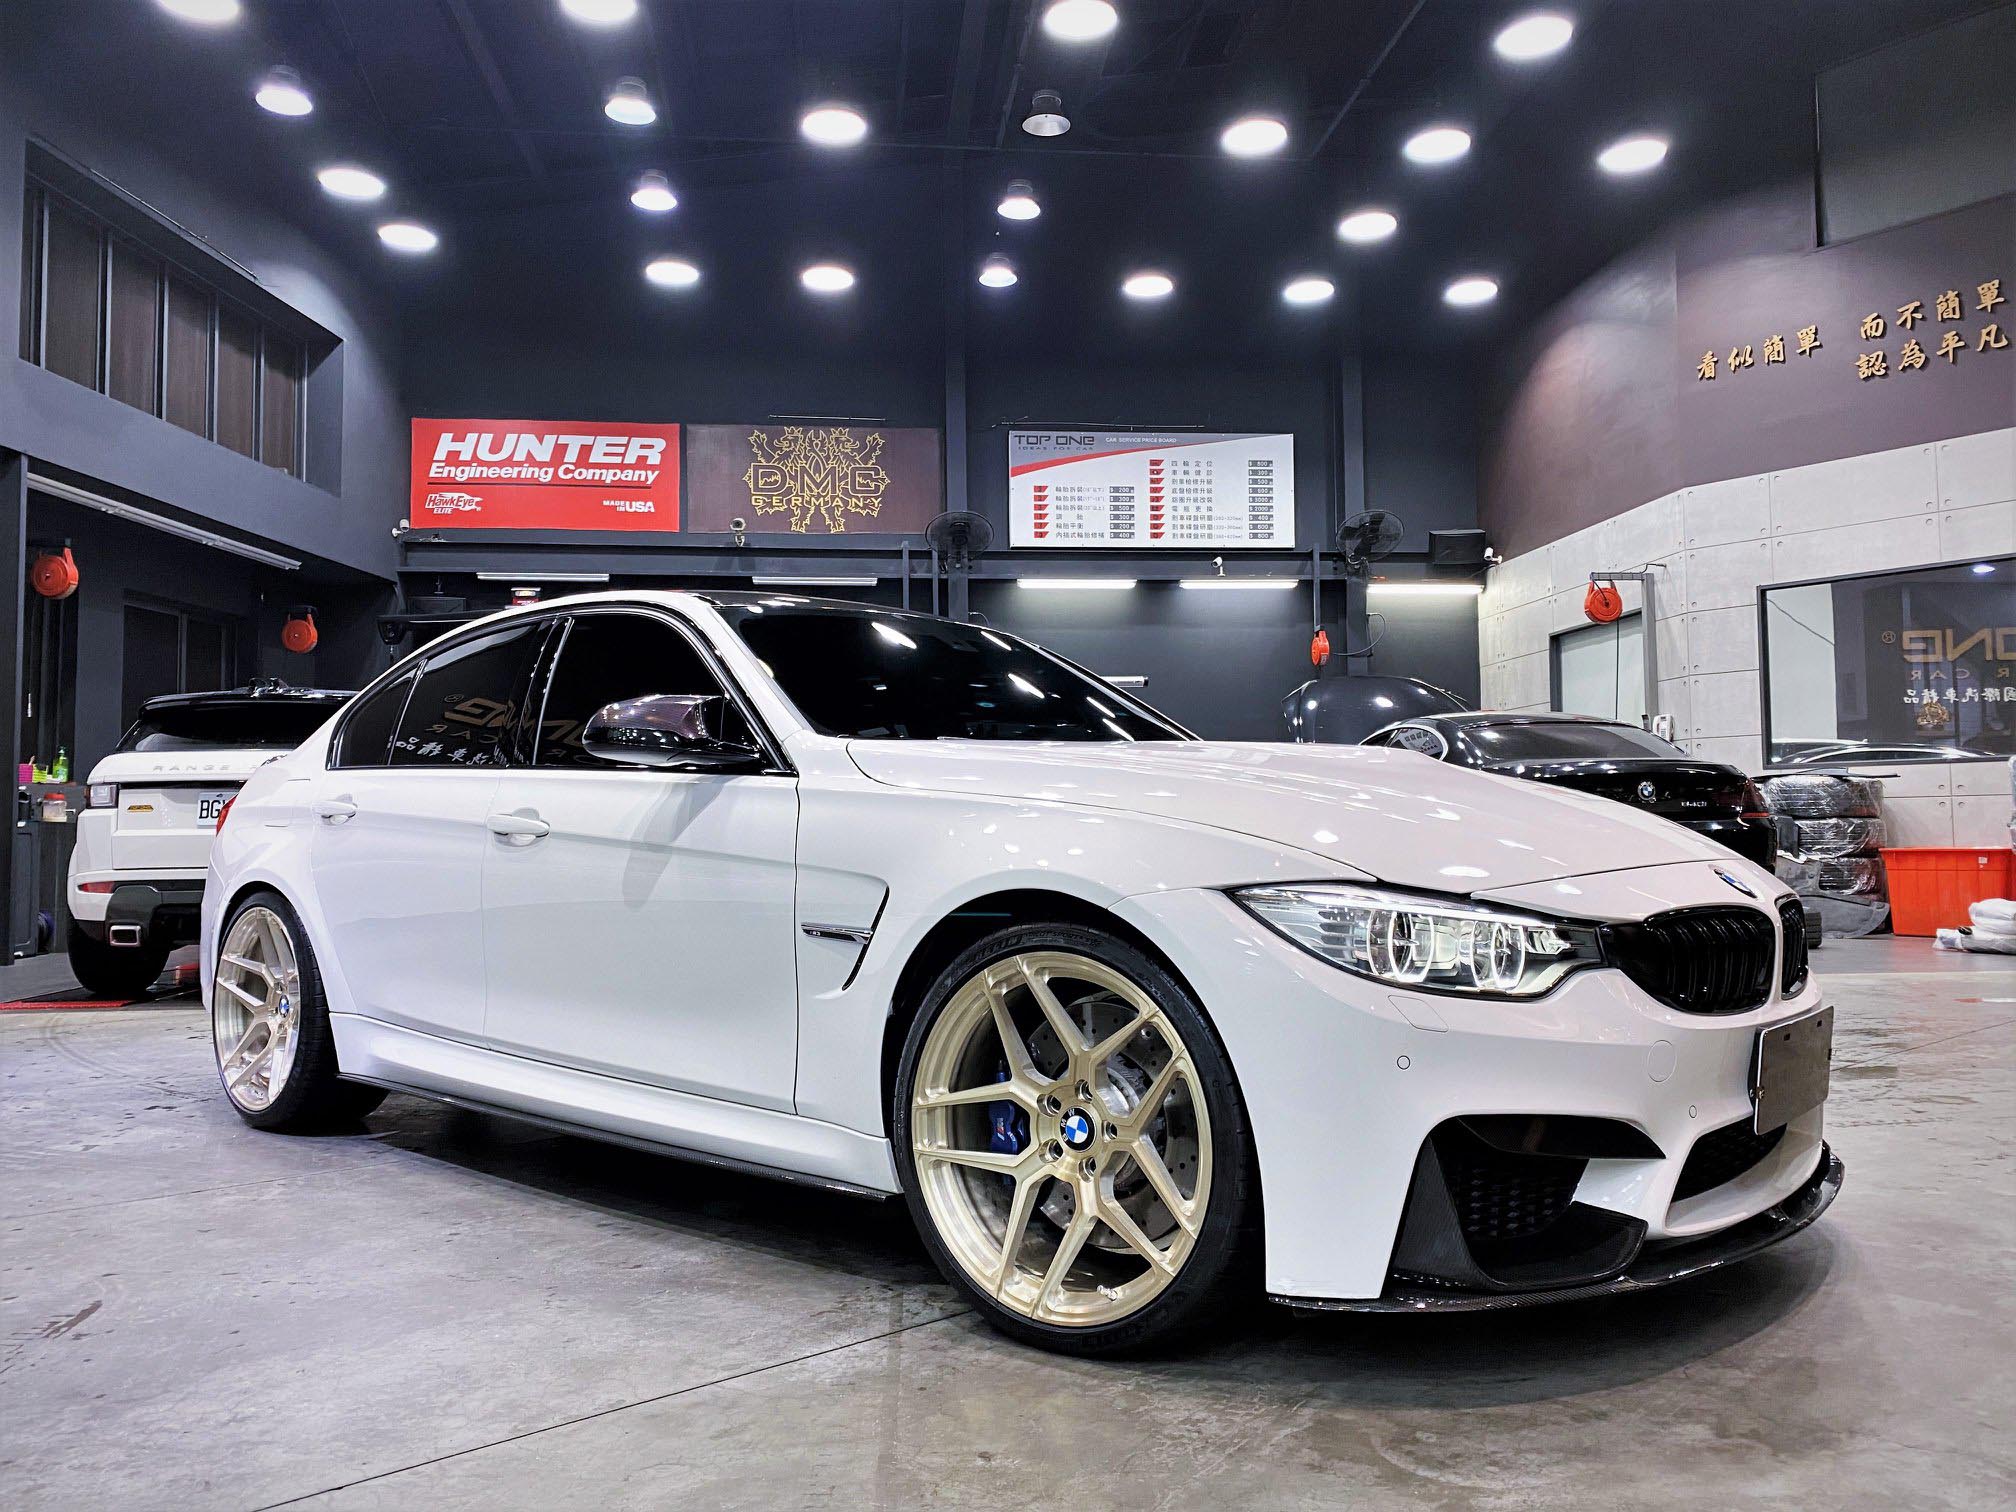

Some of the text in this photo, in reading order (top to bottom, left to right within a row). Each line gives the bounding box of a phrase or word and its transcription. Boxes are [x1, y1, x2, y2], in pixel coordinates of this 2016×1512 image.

[1860, 279, 2005, 341] 而不簡單
[1696, 324, 1823, 381] 看似簡單
[1855, 323, 2009, 381] 認為平凡
[432, 432, 667, 466] HUNTER
[1013, 435, 1051, 446] TOP
[428, 462, 660, 485] Engineering Company
[750, 462, 882, 495] DMC
[426, 495, 476, 509] HawkEye
[433, 507, 454, 515] ELITE
[625, 501, 656, 513] USA
[751, 496, 882, 507] GERMANY
[152, 764, 231, 772] RANGE
[198, 799, 226, 820] BG
